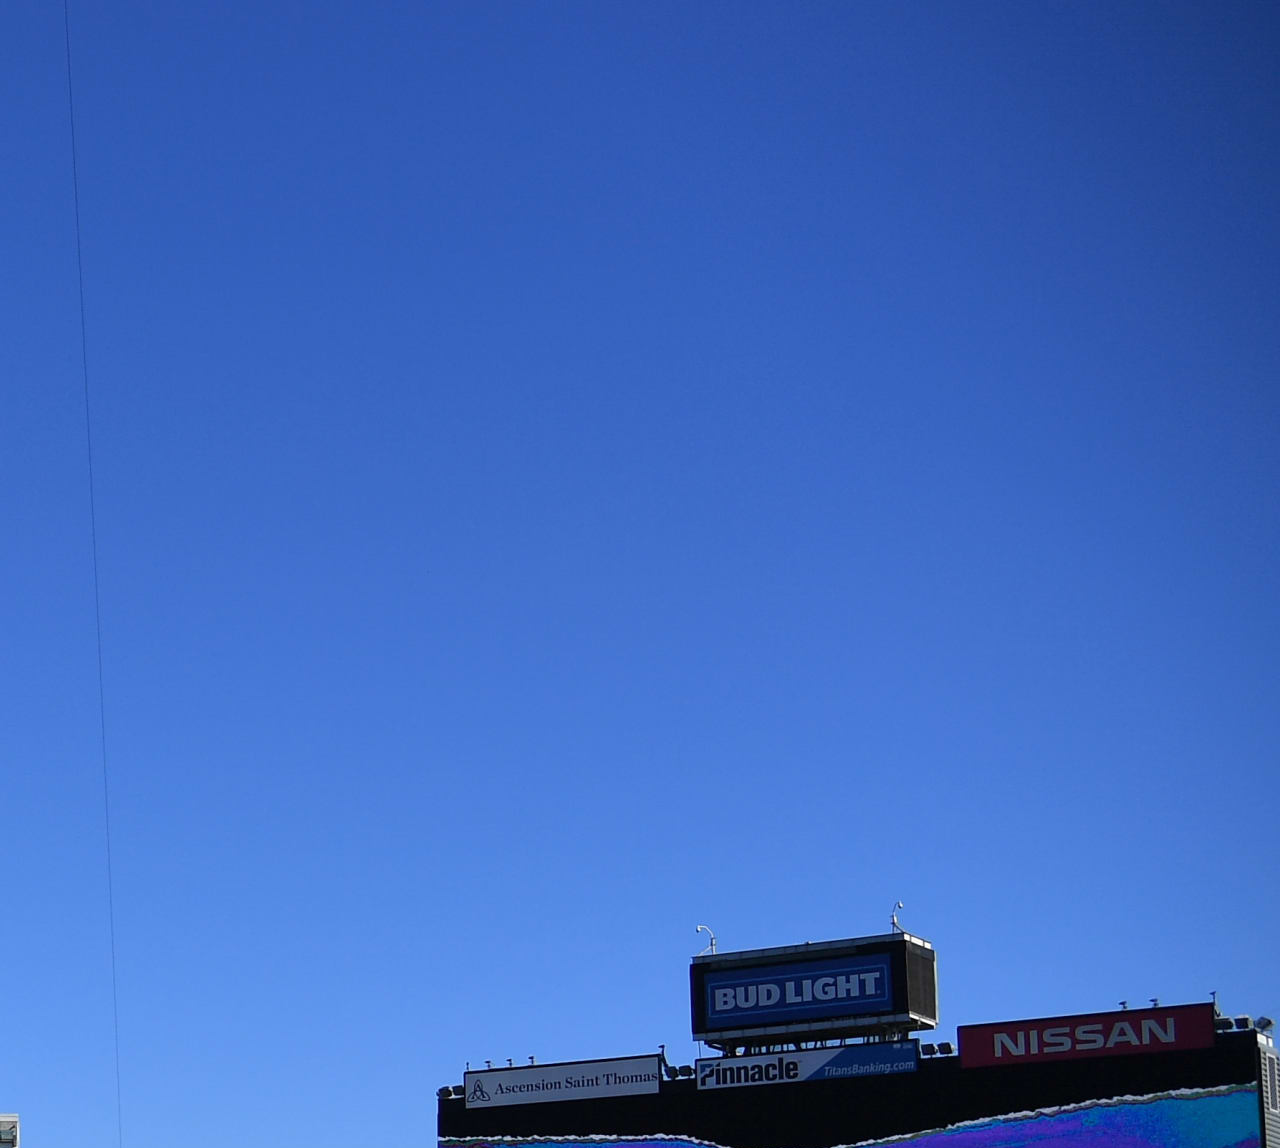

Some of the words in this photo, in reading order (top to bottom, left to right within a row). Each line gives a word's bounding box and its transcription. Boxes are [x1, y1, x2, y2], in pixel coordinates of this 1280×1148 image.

[714, 983, 781, 1011] BUD
[785, 971, 881, 1004] LIGHT
[993, 1017, 1176, 1058] NISSAN
[495, 1078, 562, 1095] Ascension
[564, 1074, 600, 1089] Saint
[602, 1071, 658, 1086] Thomas
[699, 1056, 800, 1088] Pinnacle
[824, 1060, 915, 1077] TitansBanking.com
